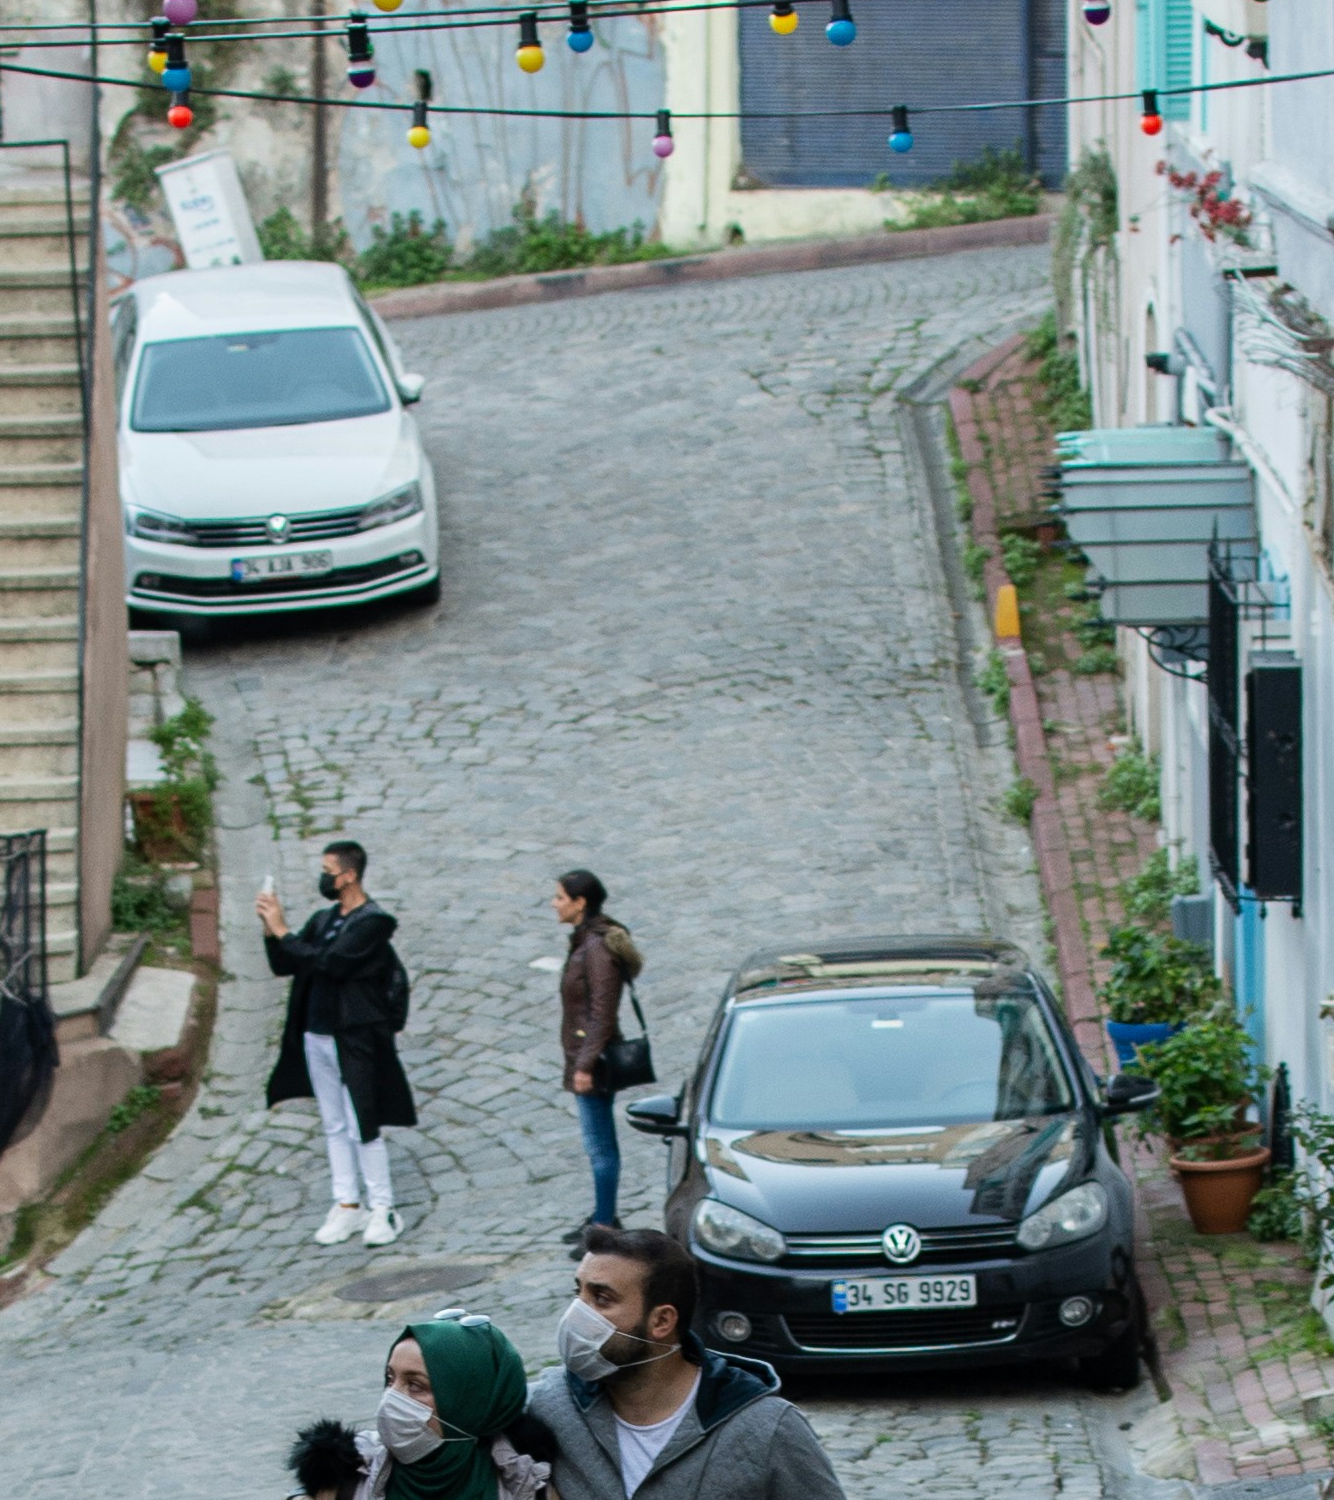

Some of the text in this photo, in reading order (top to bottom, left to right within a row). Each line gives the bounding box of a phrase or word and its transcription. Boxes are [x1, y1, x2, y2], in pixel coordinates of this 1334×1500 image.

[848, 1279, 971, 1306] 34 SG 9929
